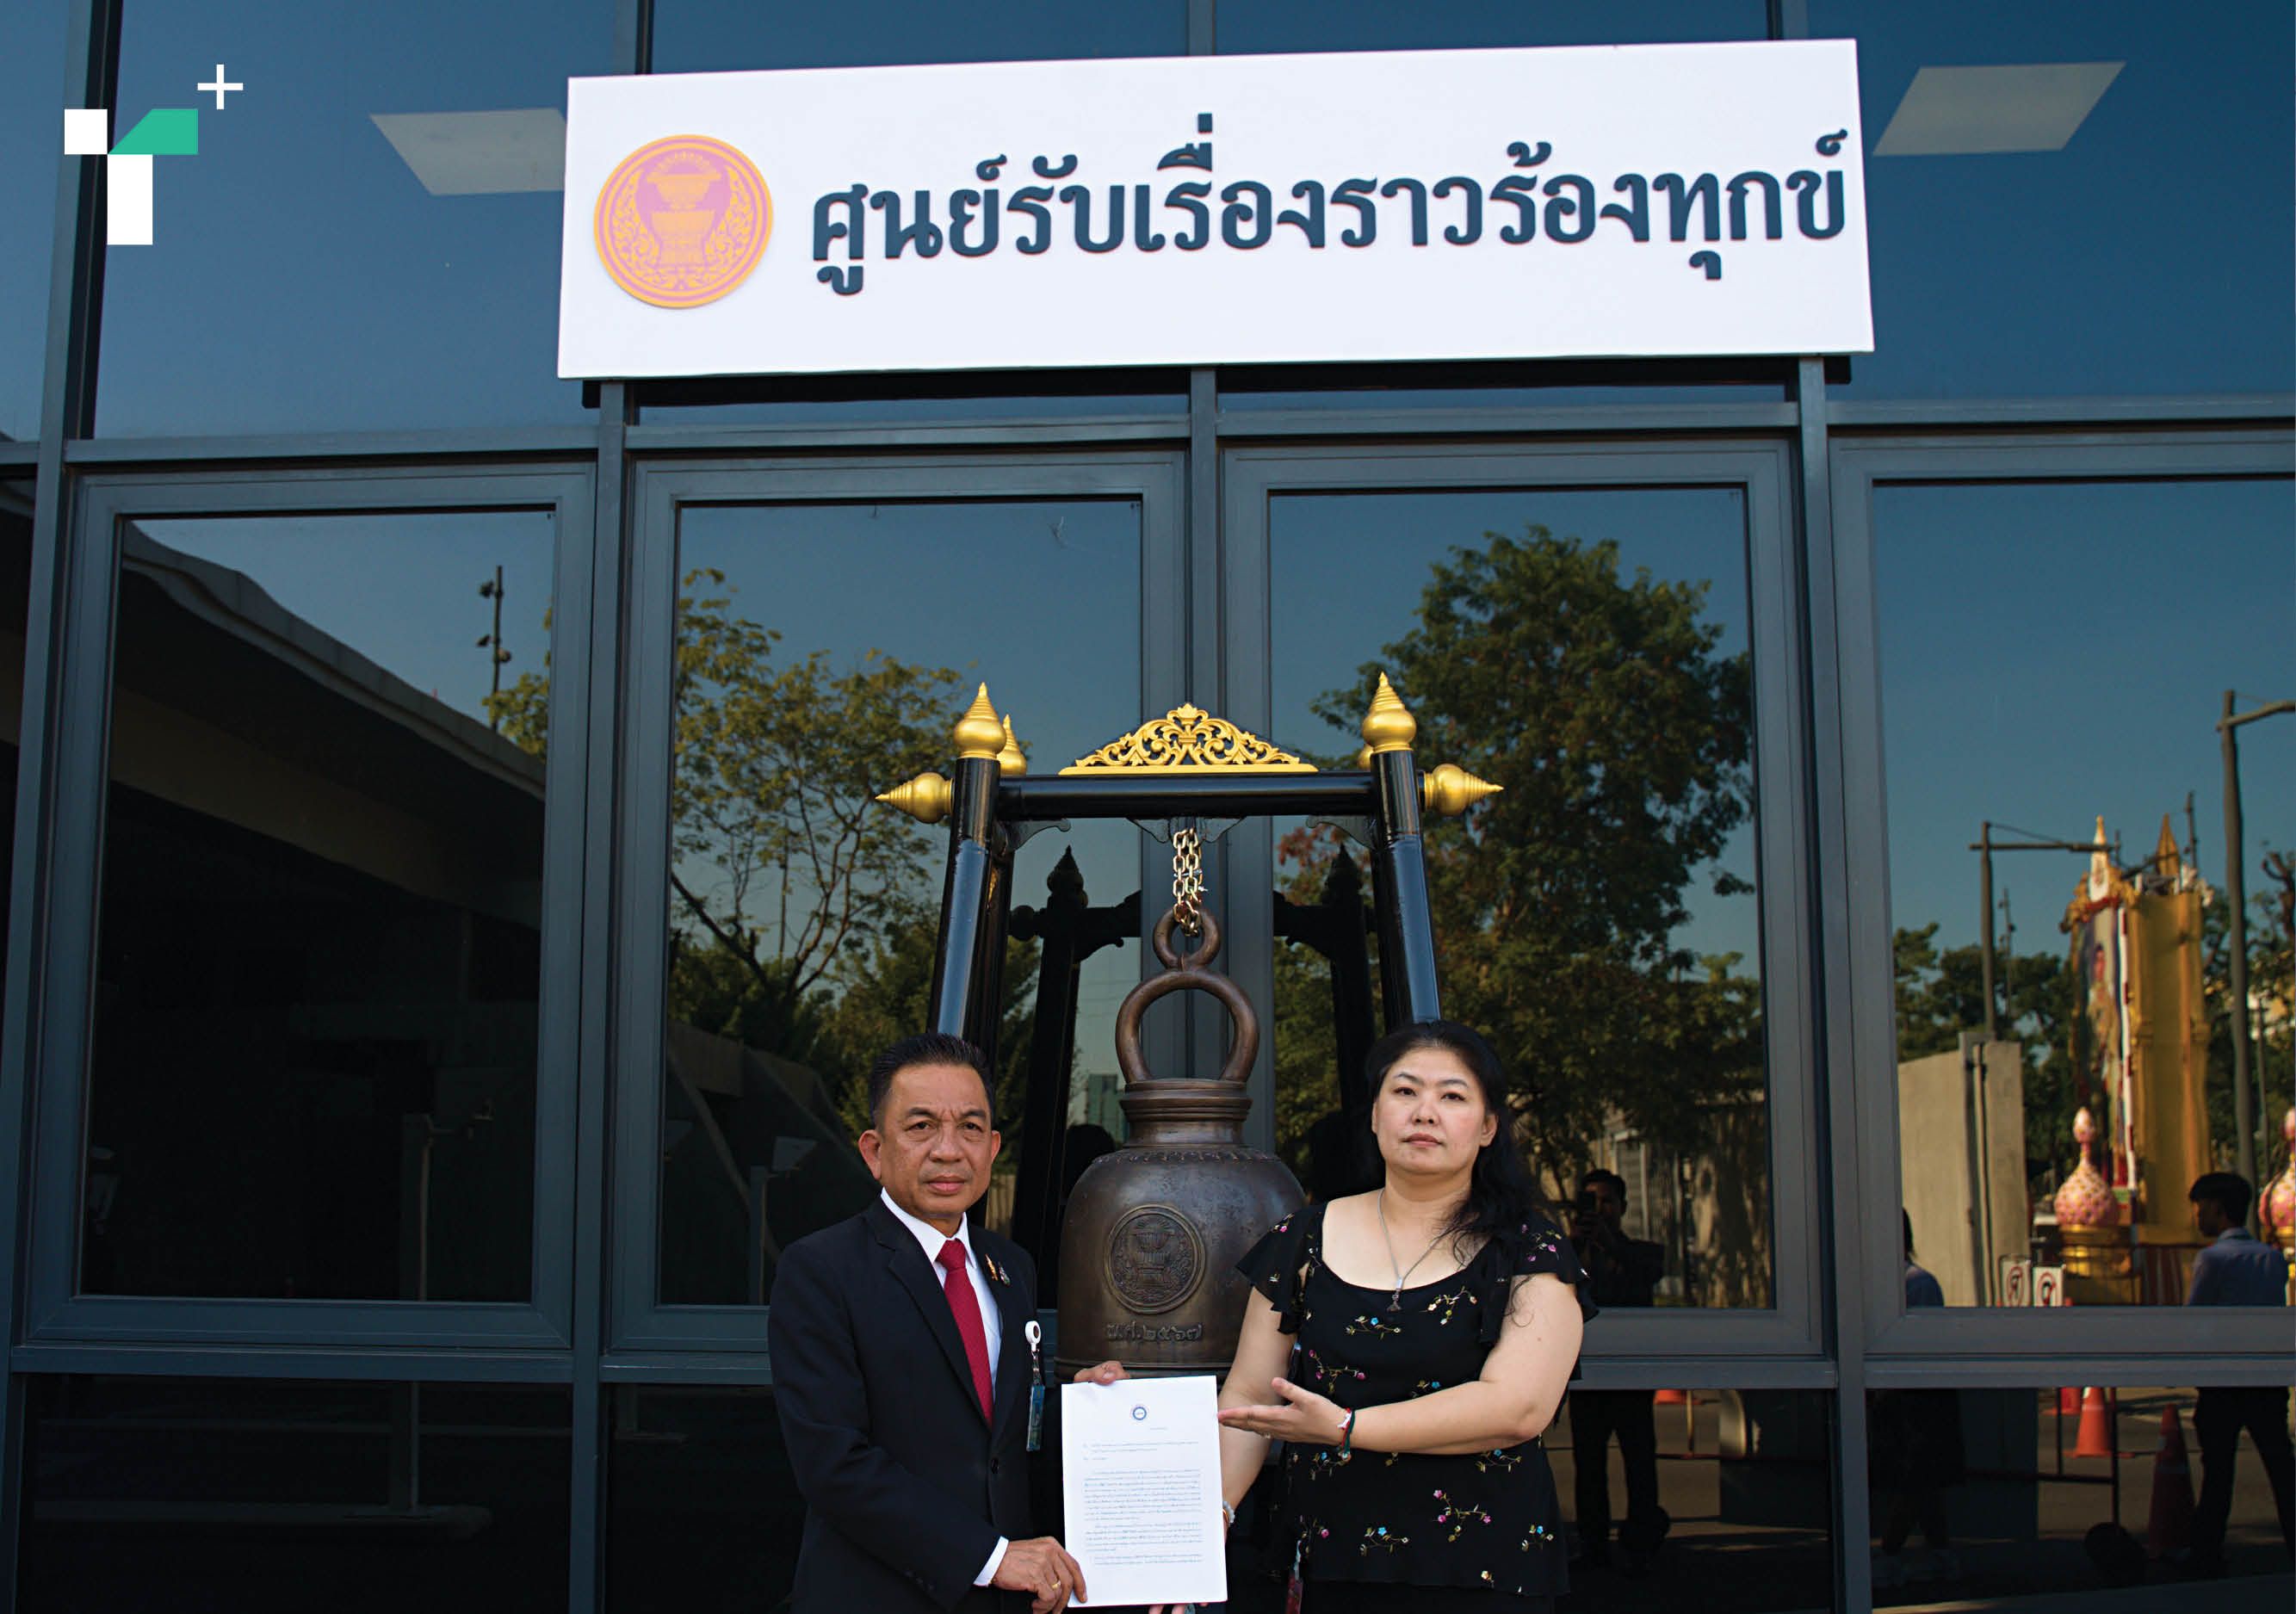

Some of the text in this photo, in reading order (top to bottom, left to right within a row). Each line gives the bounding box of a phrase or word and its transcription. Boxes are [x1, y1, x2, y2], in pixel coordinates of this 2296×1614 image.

[813, 113, 1847, 296] ศูนย์รับเรื่องราวร้องทุกข์
